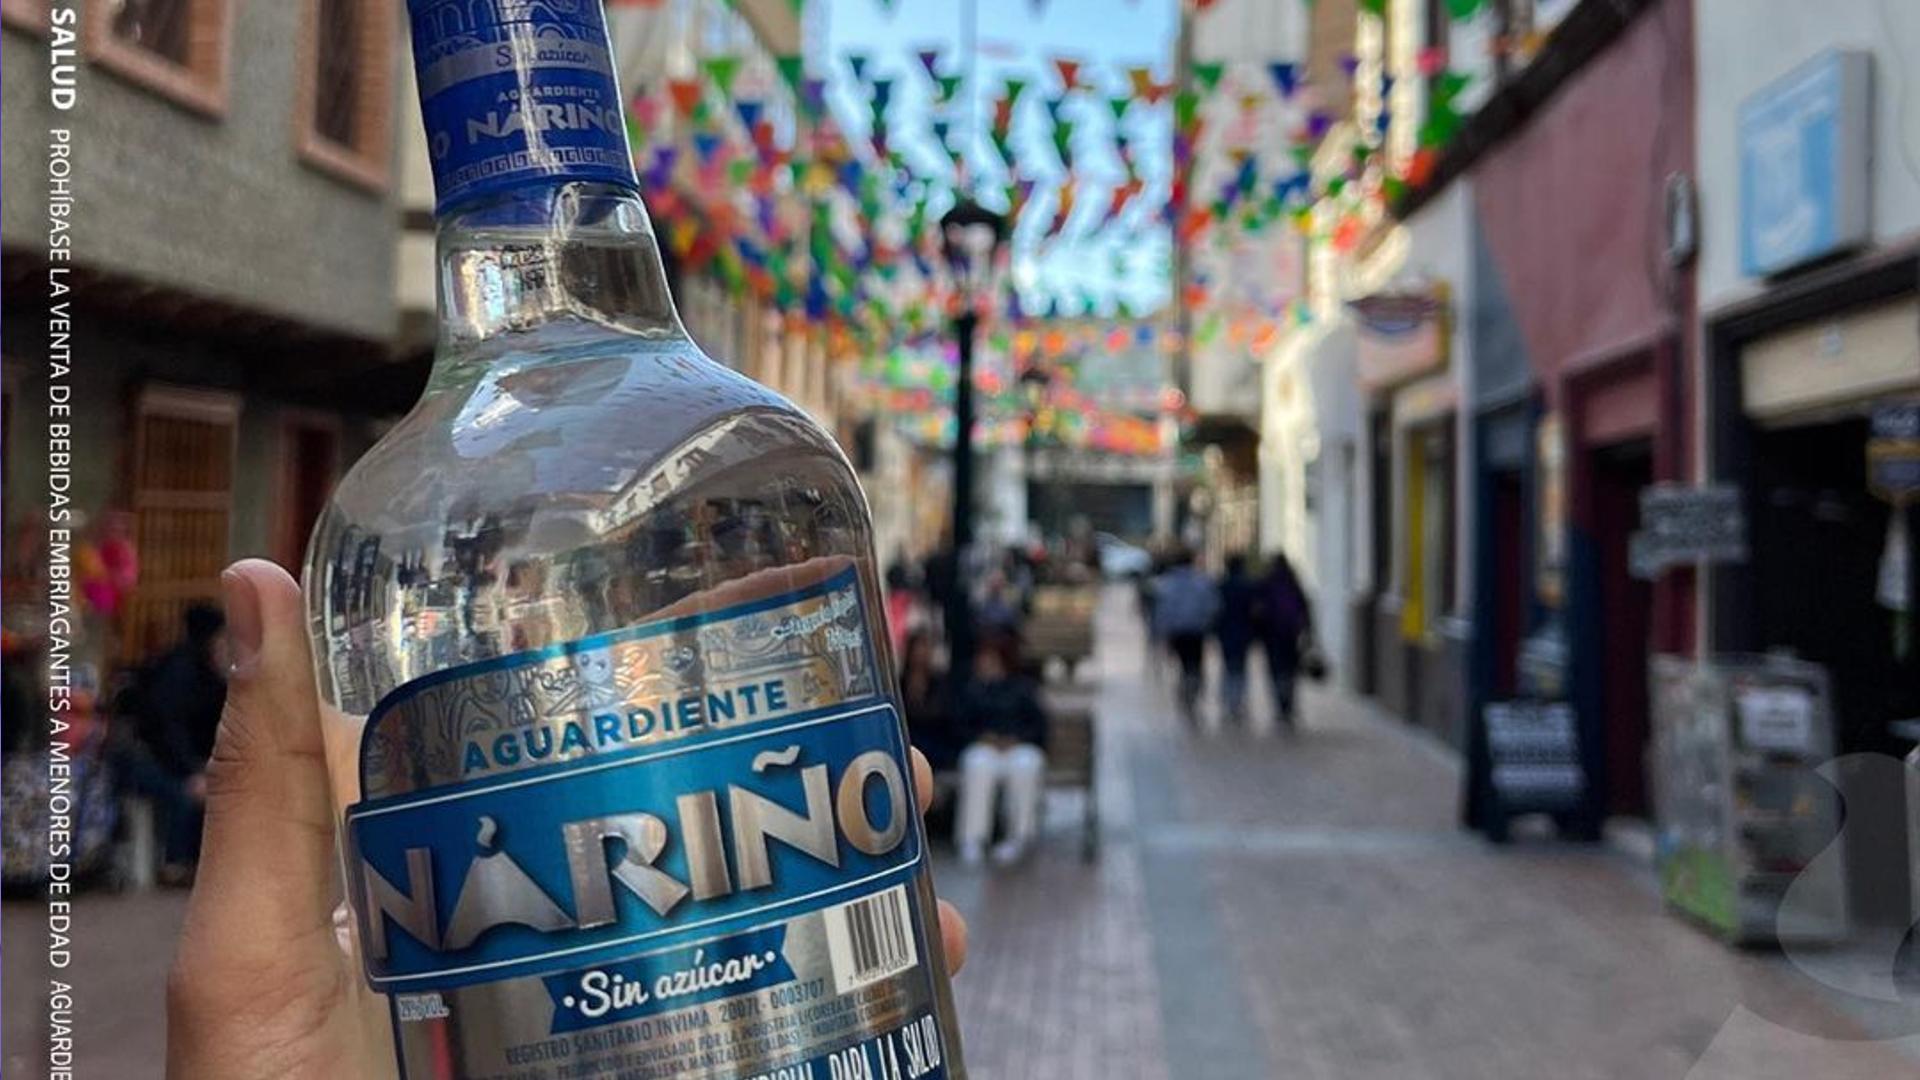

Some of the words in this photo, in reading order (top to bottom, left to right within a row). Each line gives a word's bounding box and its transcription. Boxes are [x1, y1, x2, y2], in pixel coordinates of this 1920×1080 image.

[463, 680, 788, 774] AGUARDIENTE
[579, 970, 649, 1018] Sin
[654, 948, 765, 999] azúcar
[573, 1021, 652, 1054] SANITARIO
[656, 1009, 711, 1036] INVIMA
[902, 1014, 942, 1079] SALUD
